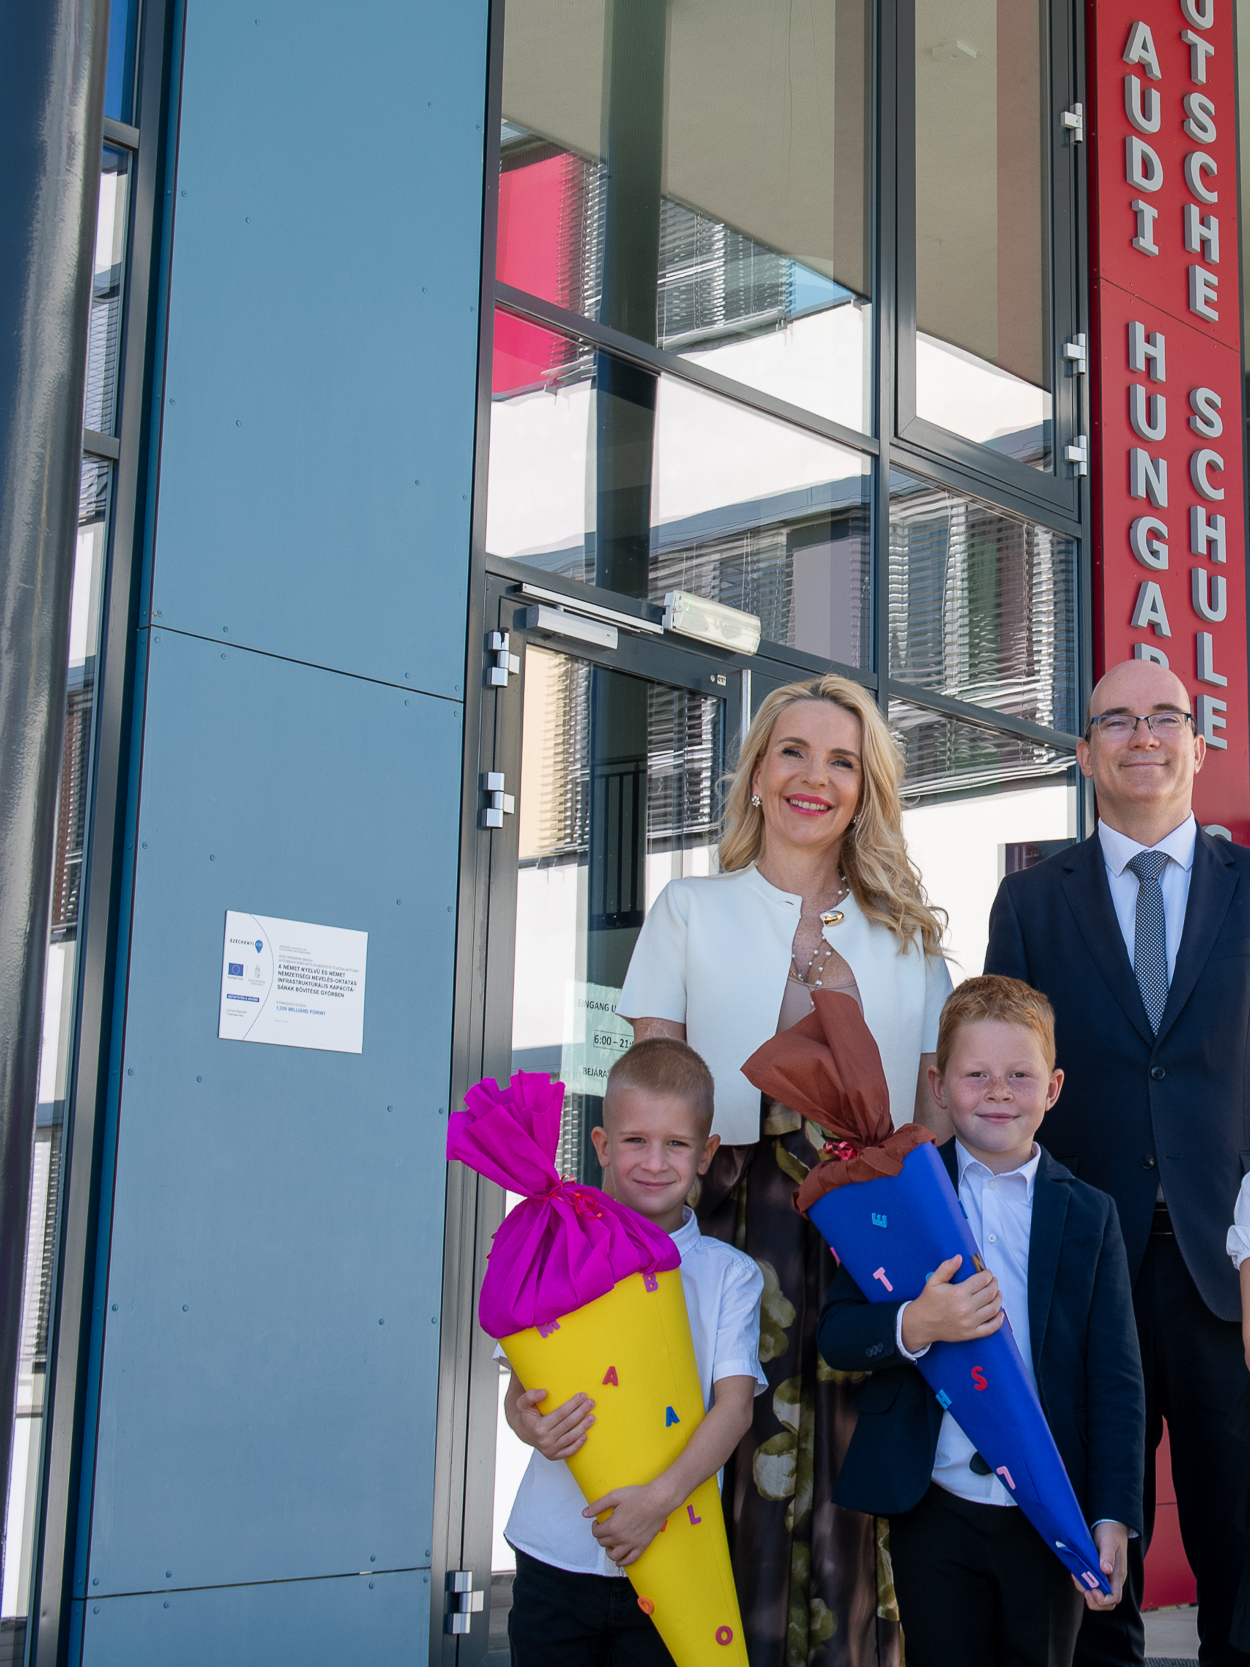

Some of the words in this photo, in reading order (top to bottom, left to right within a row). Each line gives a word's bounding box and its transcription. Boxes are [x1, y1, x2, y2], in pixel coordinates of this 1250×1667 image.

[1122, 21, 1164, 257] AUDI
[1189, 387, 1228, 750] SCHULE
[278, 971, 311, 980] NEMZETISÉGI
[329, 970, 346, 978] NÉMET
[277, 984, 294, 992] SÁNAK
[578, 999, 609, 1012] EINGANG
[594, 1034, 612, 1046] 6:00
[602, 1366, 618, 1386] A
[971, 1366, 988, 1392] S
[666, 1406, 680, 1427] A
[687, 1504, 702, 1525] L
